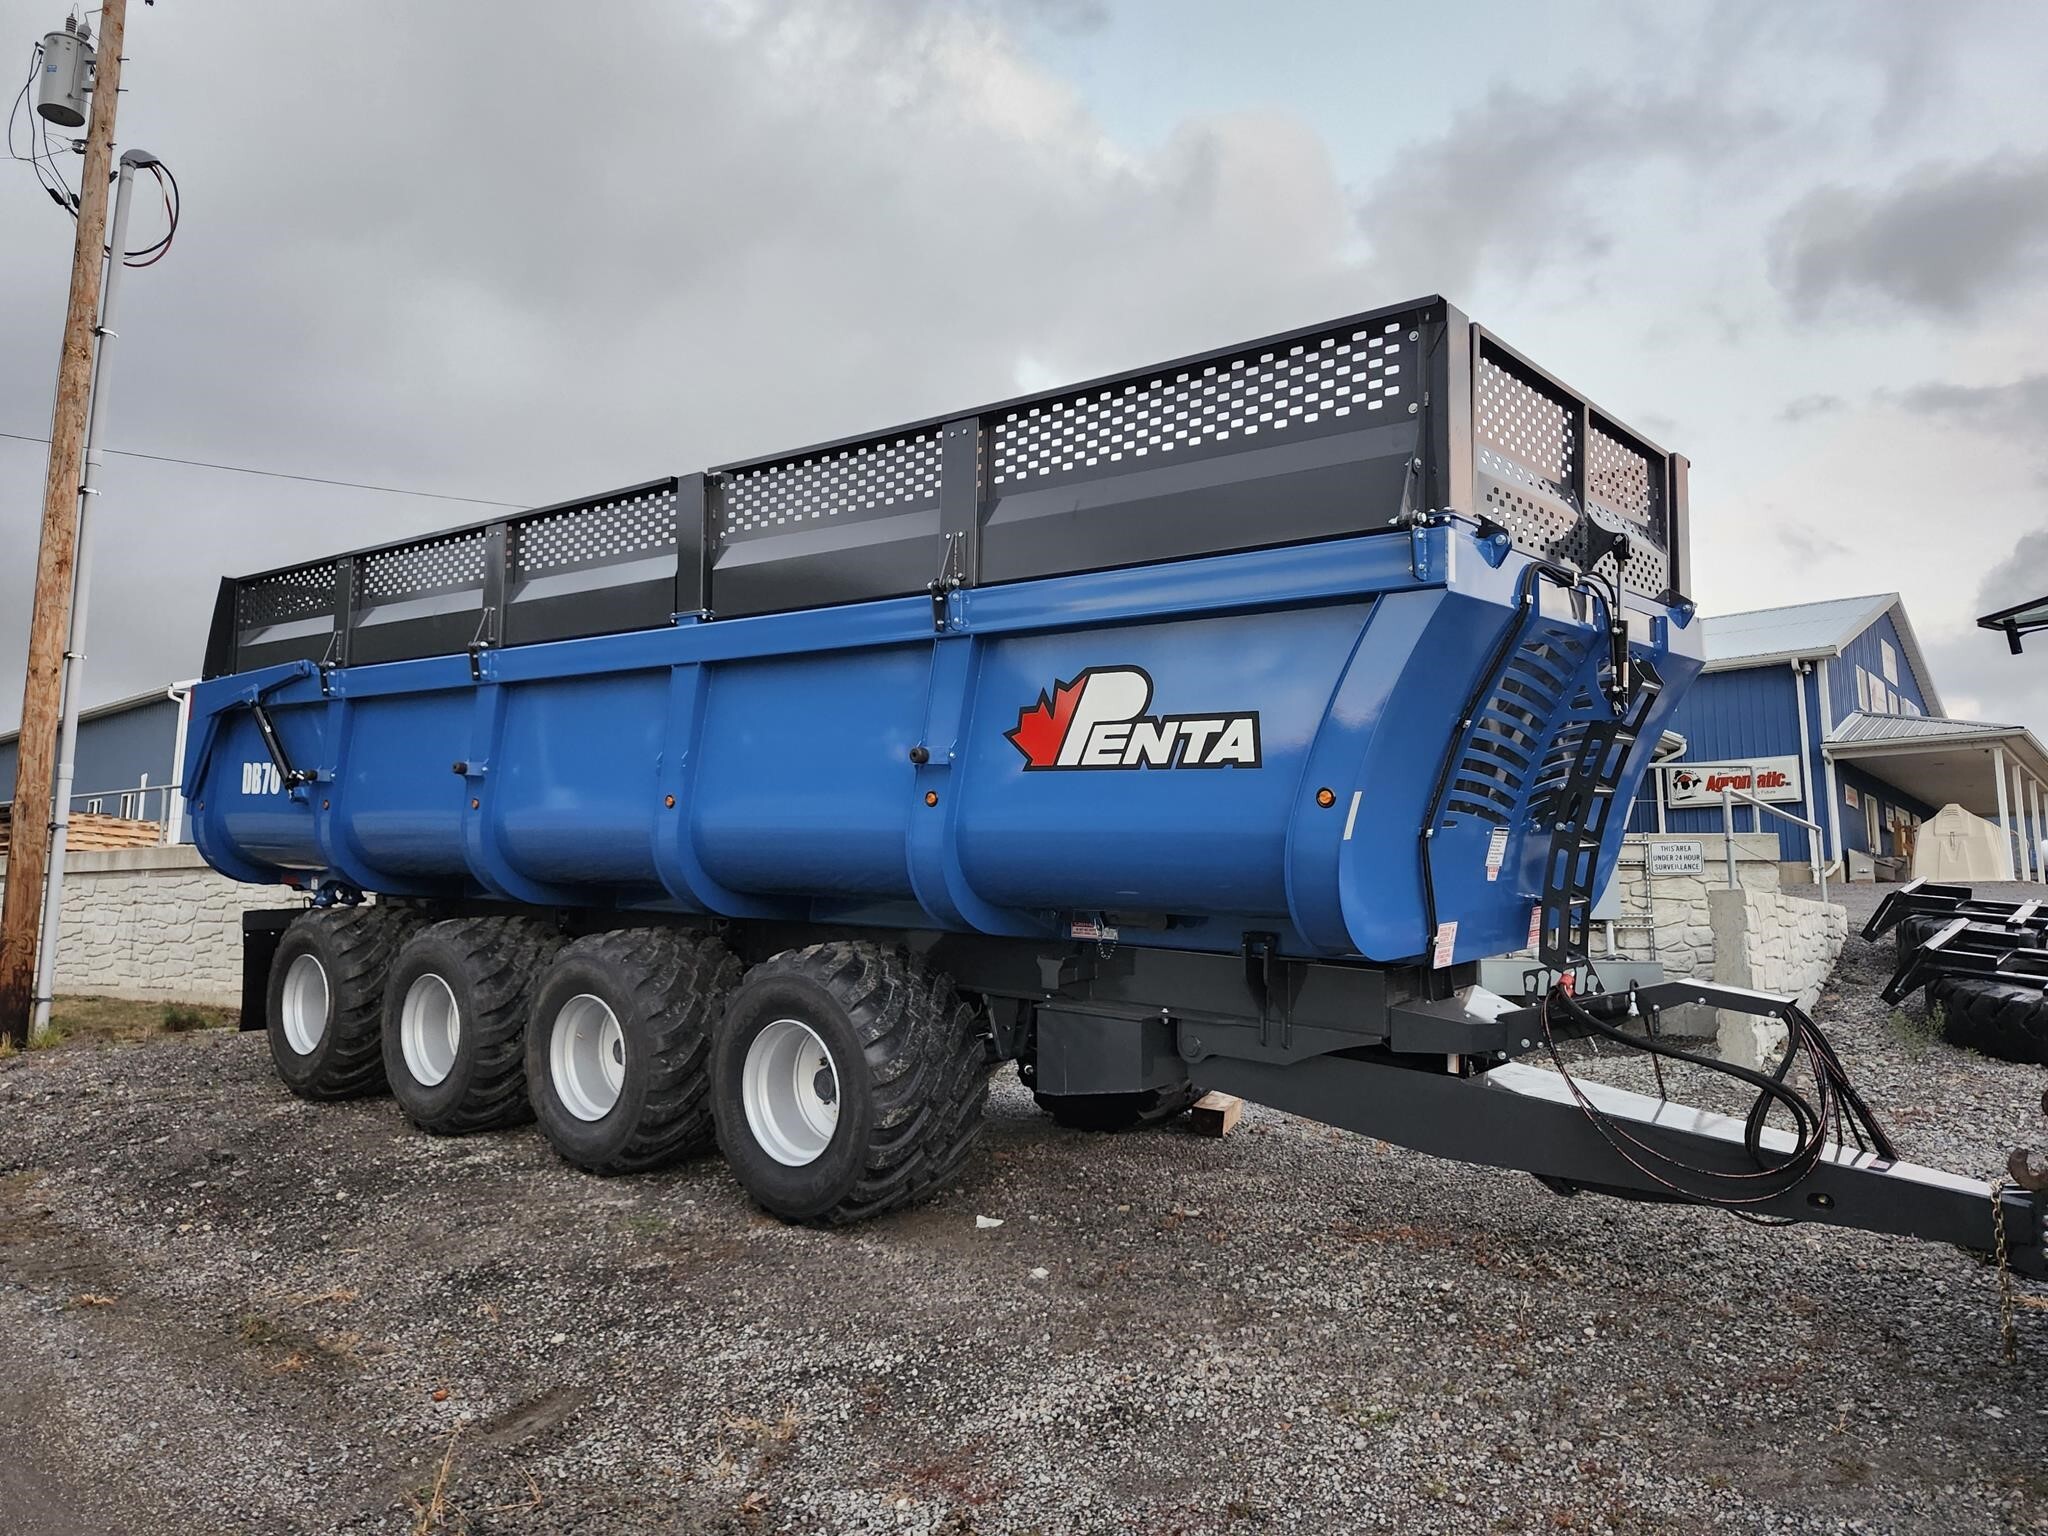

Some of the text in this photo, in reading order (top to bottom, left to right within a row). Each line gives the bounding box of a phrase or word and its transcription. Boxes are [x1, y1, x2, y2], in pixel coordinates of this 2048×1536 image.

[1056, 670, 1257, 767] PENTA
[242, 762, 281, 795] DB70
[1654, 863, 1700, 871] SURVEILLANCE
